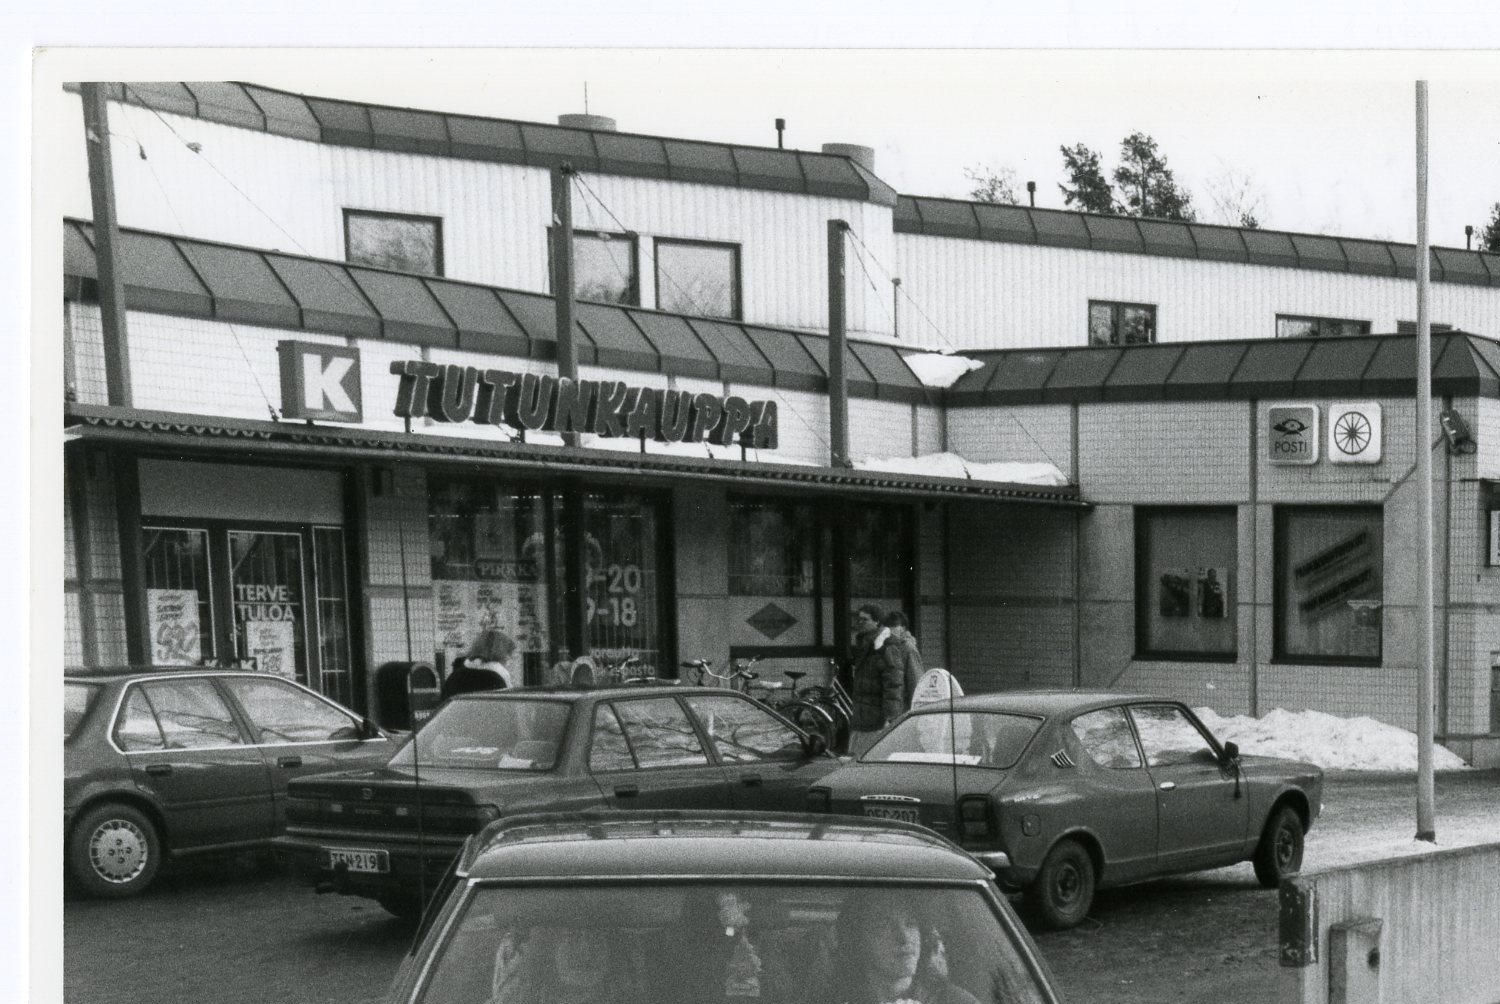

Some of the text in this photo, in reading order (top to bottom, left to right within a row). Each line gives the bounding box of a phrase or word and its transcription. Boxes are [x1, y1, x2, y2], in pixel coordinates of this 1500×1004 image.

[301, 353, 356, 414] K
[390, 359, 779, 449] TUTUNKAUPPA
[1275, 441, 1307, 453] POSTI
[237, 584, 293, 601] TERVE-
[237, 604, 295, 622] TULOA
